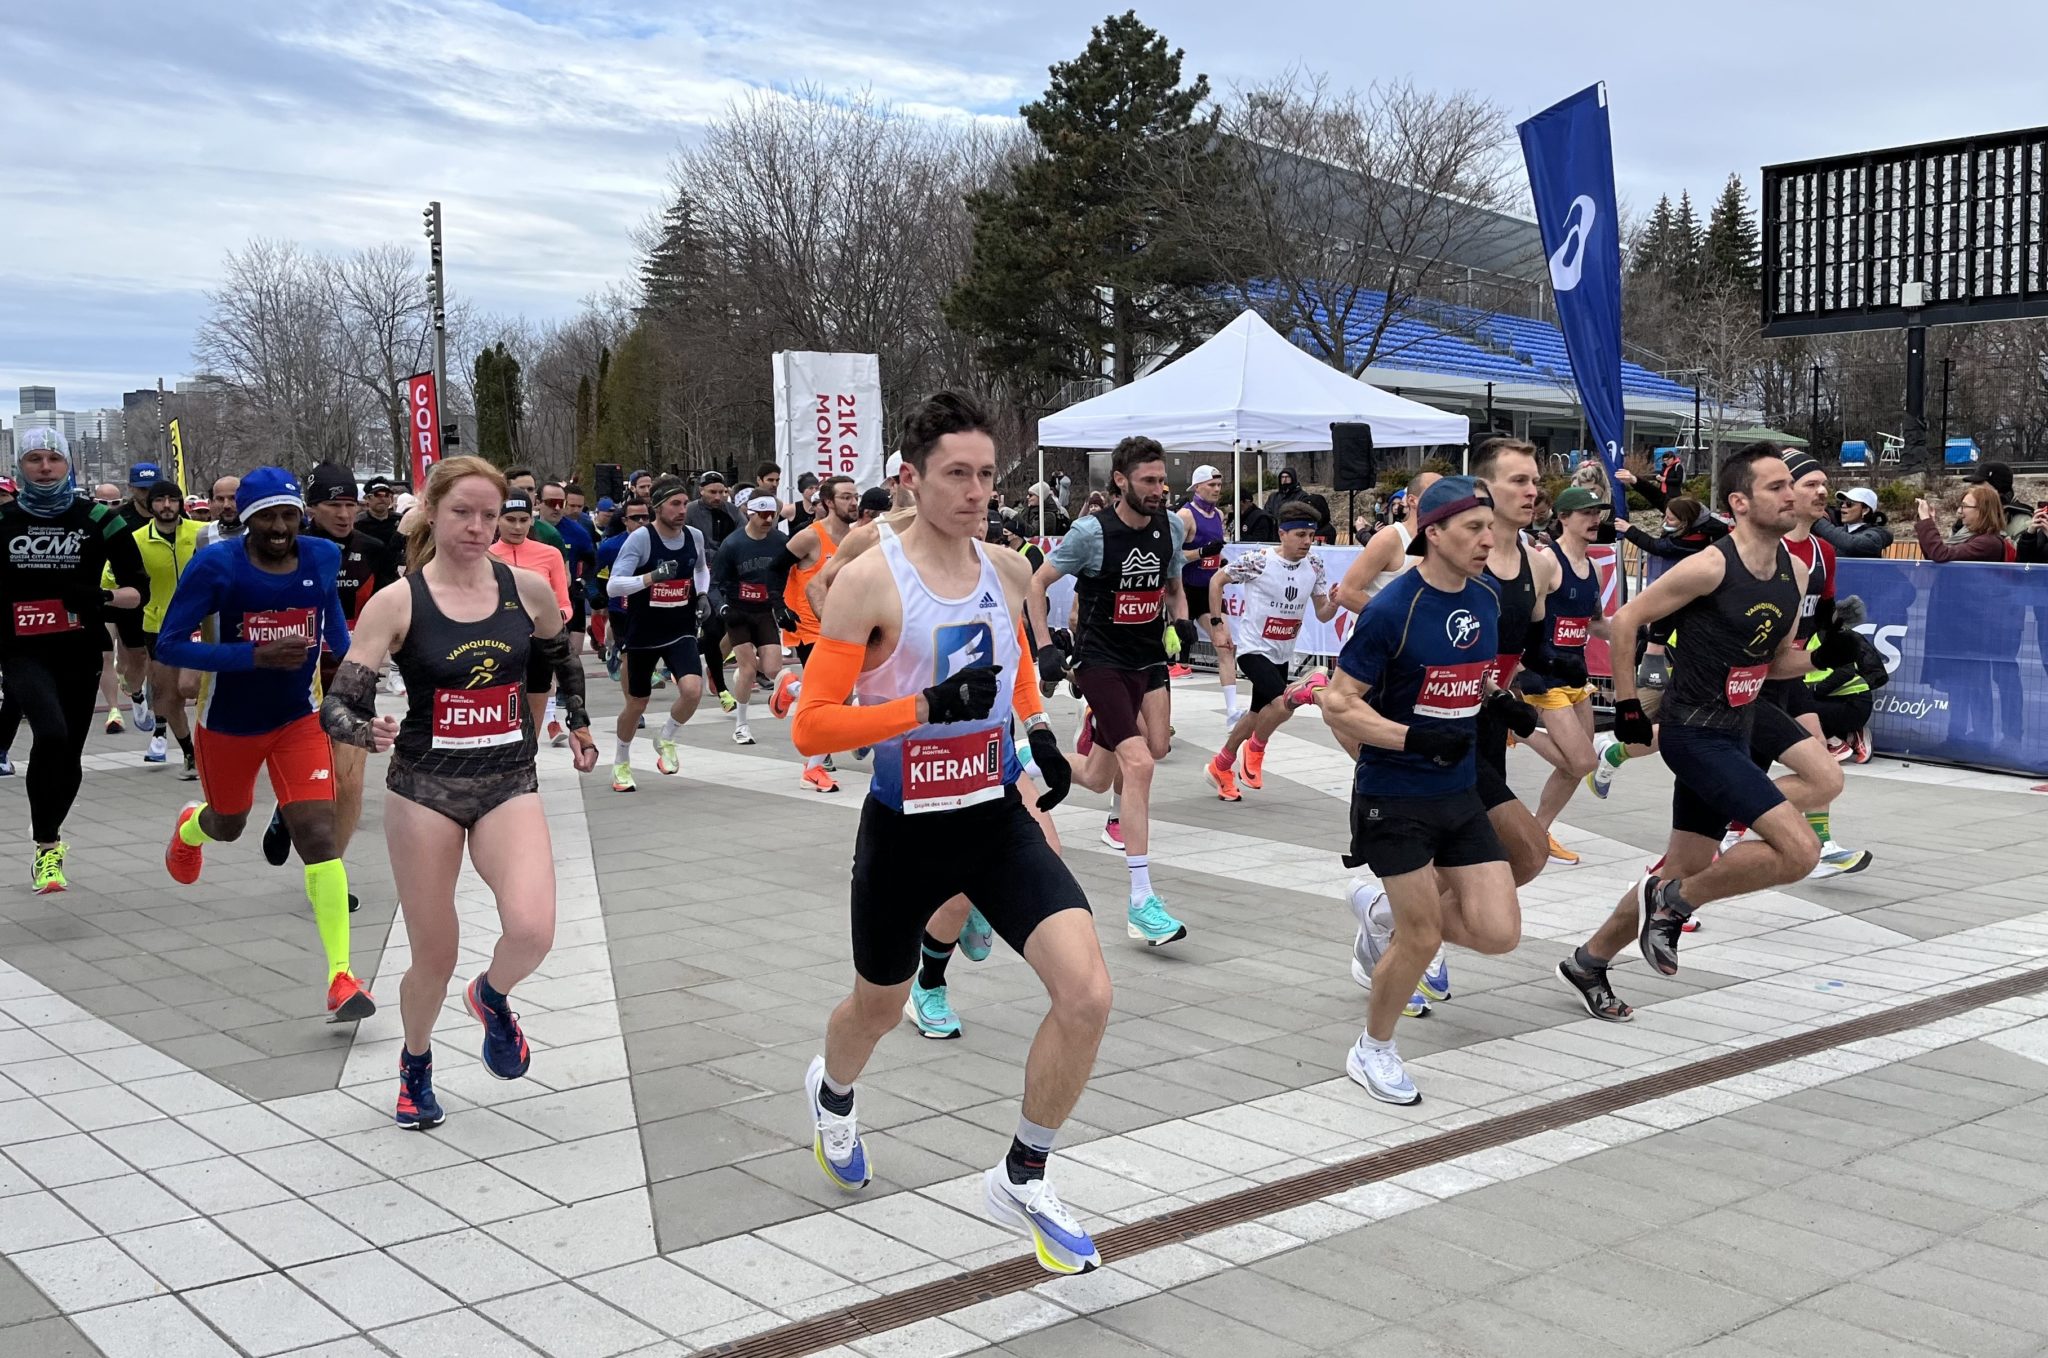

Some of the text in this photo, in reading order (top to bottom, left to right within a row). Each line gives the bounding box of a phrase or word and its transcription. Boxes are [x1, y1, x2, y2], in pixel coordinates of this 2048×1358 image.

[837, 394, 858, 473] 21K de
[9, 535, 73, 555] QCM
[652, 587, 684, 597] STÉPHANE
[1119, 602, 1158, 615] KEVIN
[1745, 602, 1783, 619] VAINQUEURS
[18, 612, 56, 626] 2772
[248, 622, 305, 641] WENDIMU
[446, 639, 512, 661] VAINQUEURS
[1424, 680, 1480, 697] MAXIME
[440, 704, 502, 726] JENN
[911, 754, 985, 783] KIERAN
